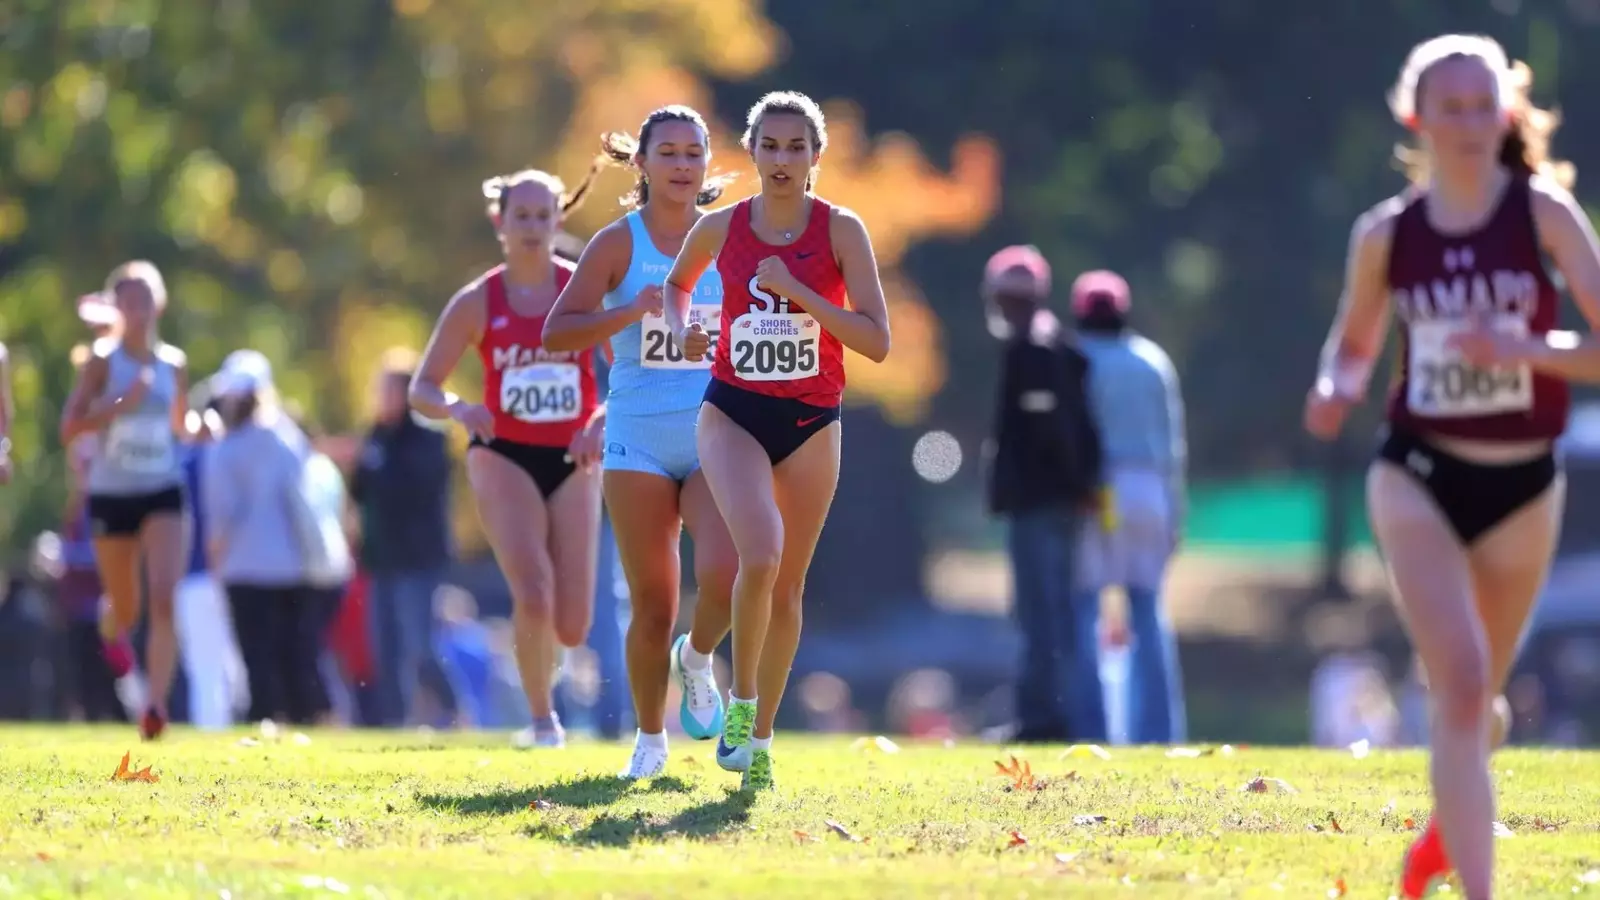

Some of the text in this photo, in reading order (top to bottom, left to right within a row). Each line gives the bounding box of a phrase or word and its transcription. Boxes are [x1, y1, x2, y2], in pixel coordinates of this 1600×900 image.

[753, 327, 799, 336] COACHES
[760, 319, 792, 328] SHORE
[645, 329, 721, 363] 205
[735, 338, 815, 374] 2095
[507, 385, 576, 415] 2048
